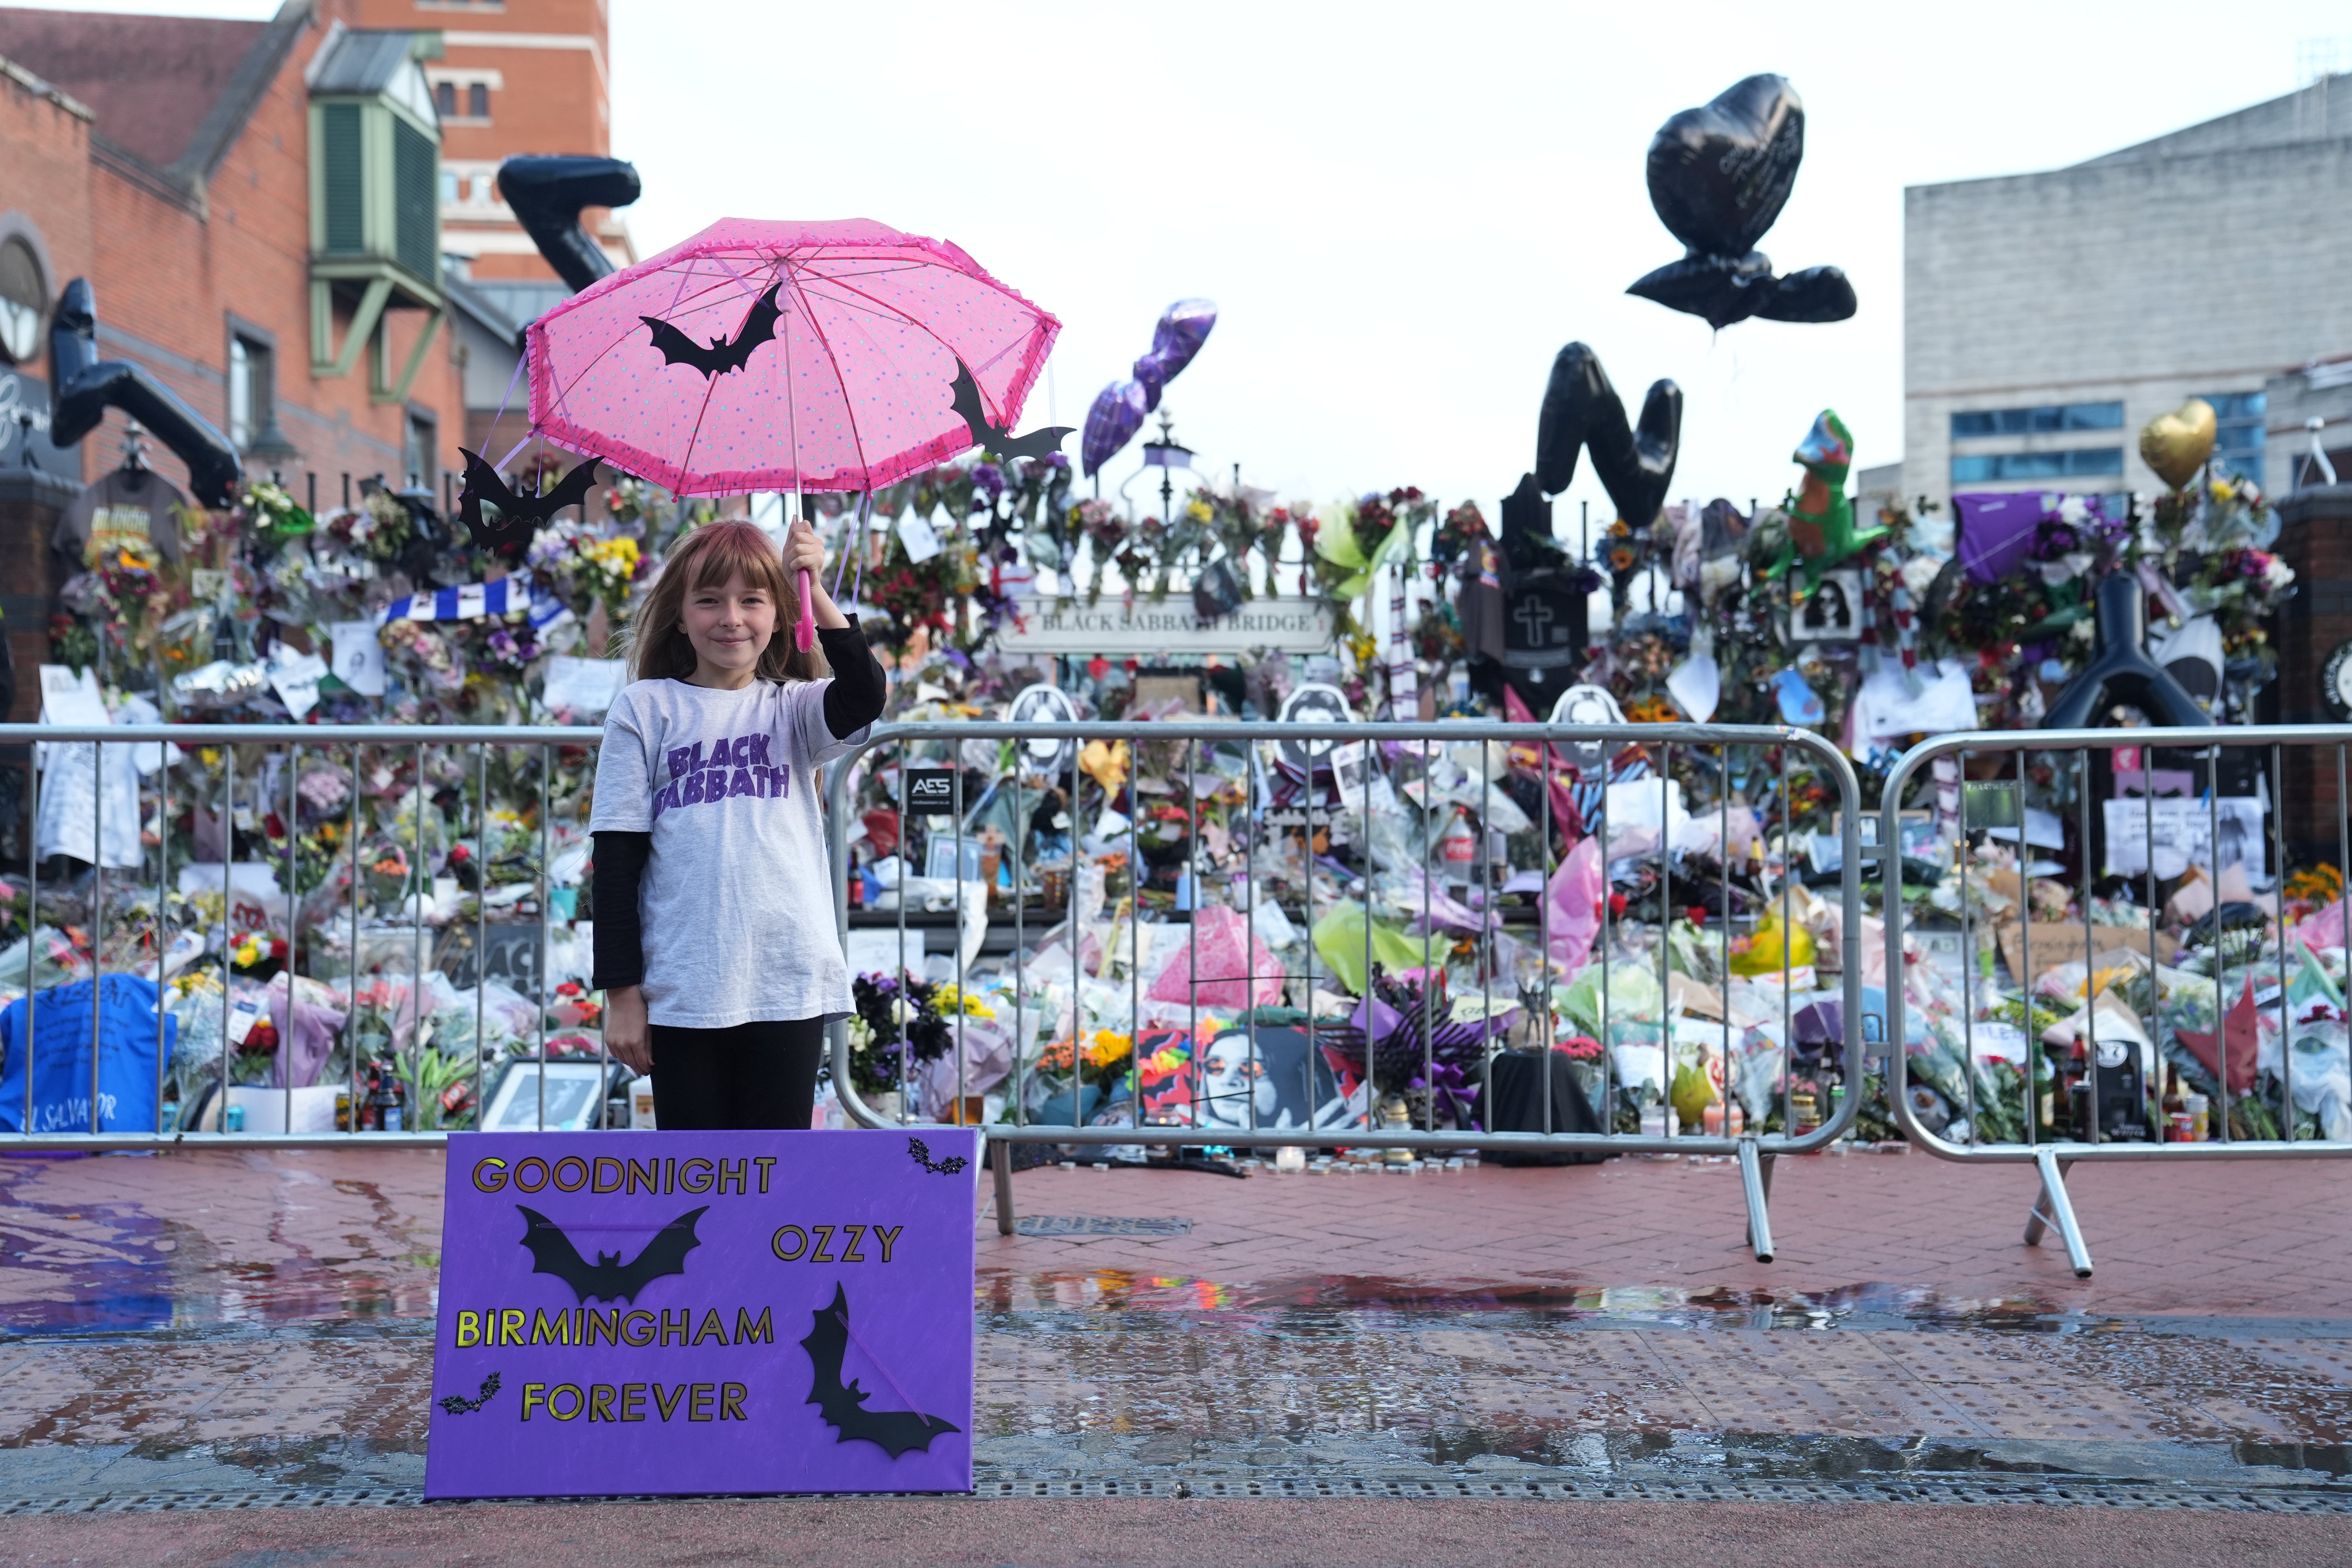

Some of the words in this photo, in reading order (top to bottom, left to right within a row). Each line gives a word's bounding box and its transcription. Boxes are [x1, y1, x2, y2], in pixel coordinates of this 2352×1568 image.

[1042, 614, 1112, 632] BLACK
[1119, 614, 1218, 632] SABBA
[1229, 614, 1312, 632] BRIDGE
[667, 733, 771, 780] BLACK
[911, 778, 951, 793] AES
[42, 1092, 117, 1132] SALVAOR
[472, 1156, 777, 1195] GOODNIGHT
[772, 1225, 904, 1263] OZZY
[455, 1306, 774, 1348] BIRMINGHAM
[521, 1382, 748, 1423] FOREVER
